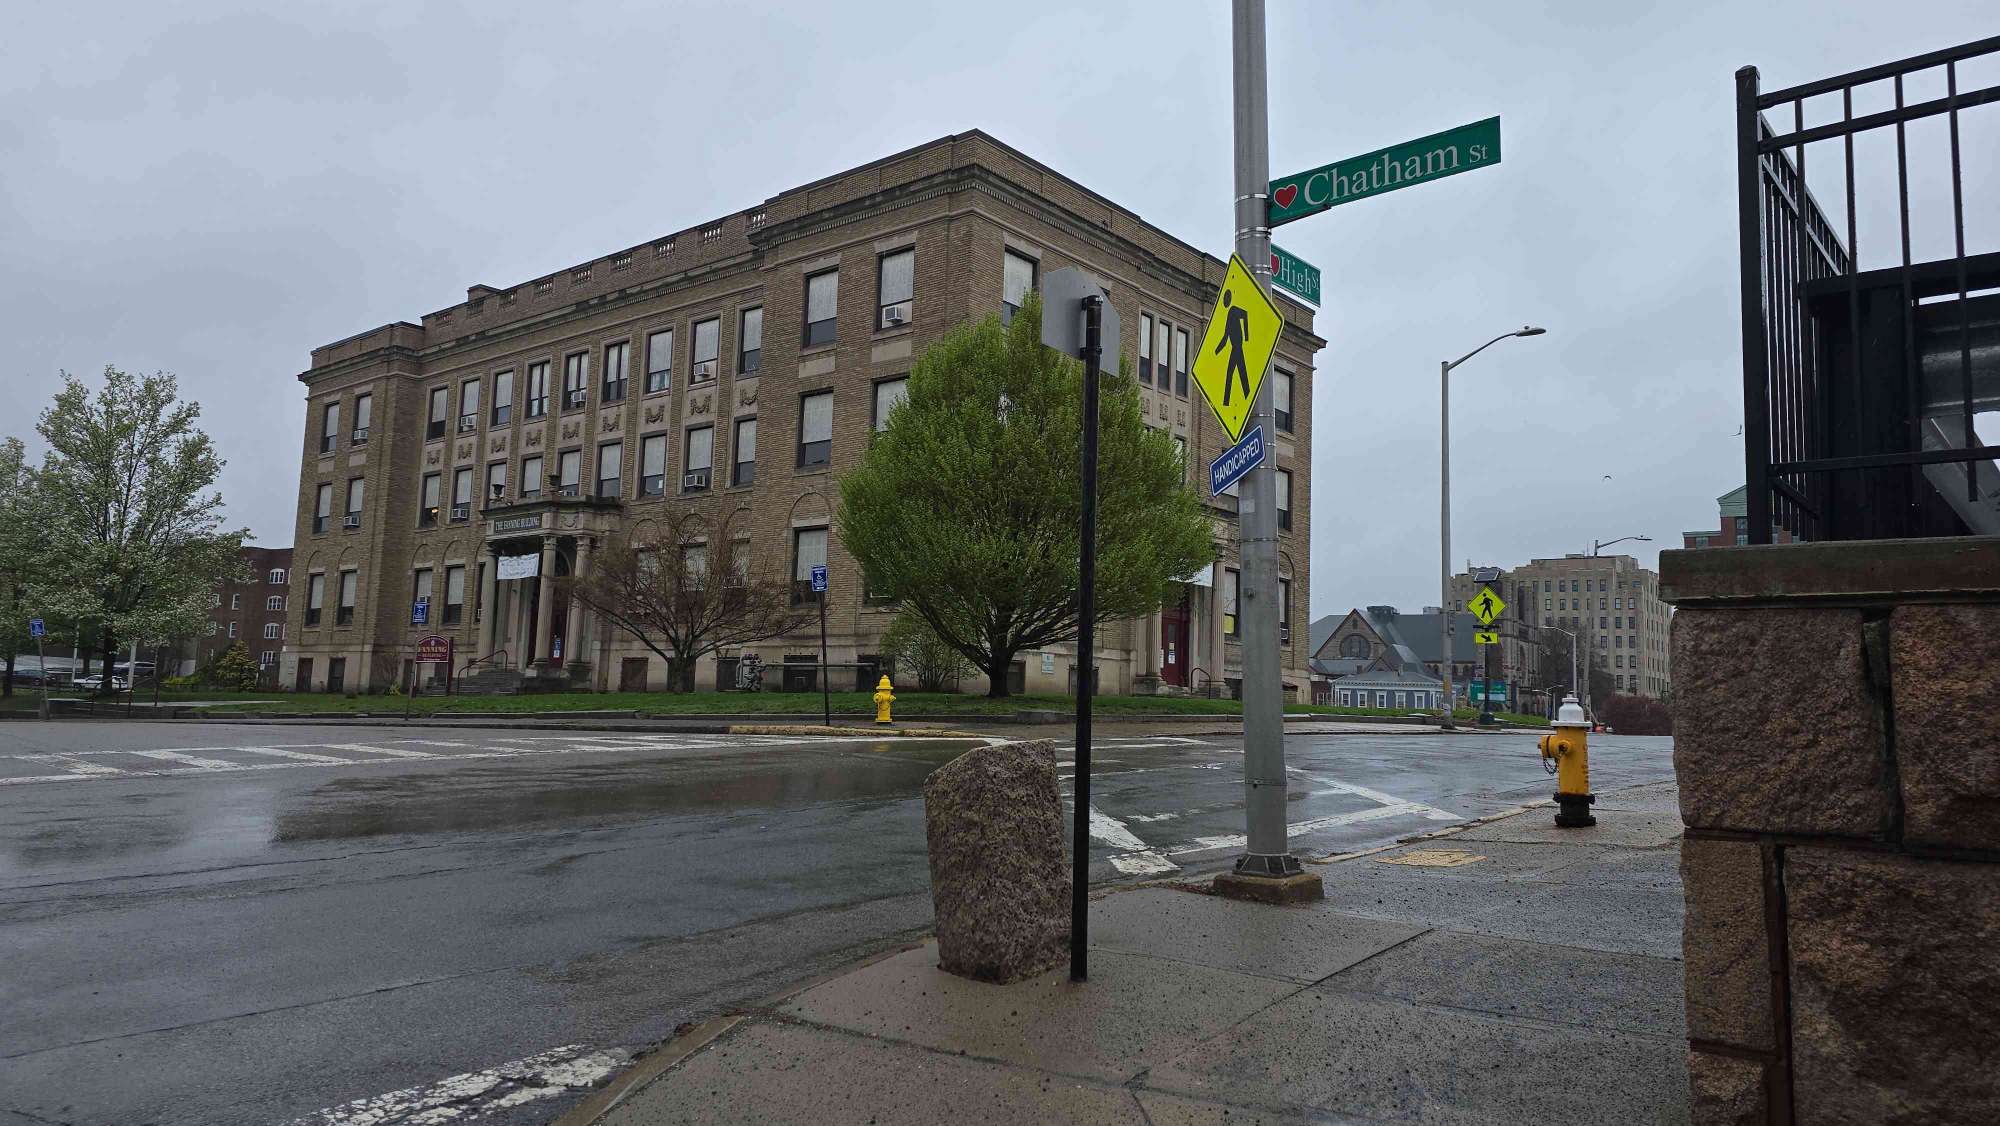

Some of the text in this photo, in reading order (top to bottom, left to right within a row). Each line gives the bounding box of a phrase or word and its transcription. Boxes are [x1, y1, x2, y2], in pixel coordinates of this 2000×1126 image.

[1304, 143, 1489, 206] Chatham St
[1281, 255, 1320, 294] High St
[1214, 438, 1260, 485] HANDICAPPED
